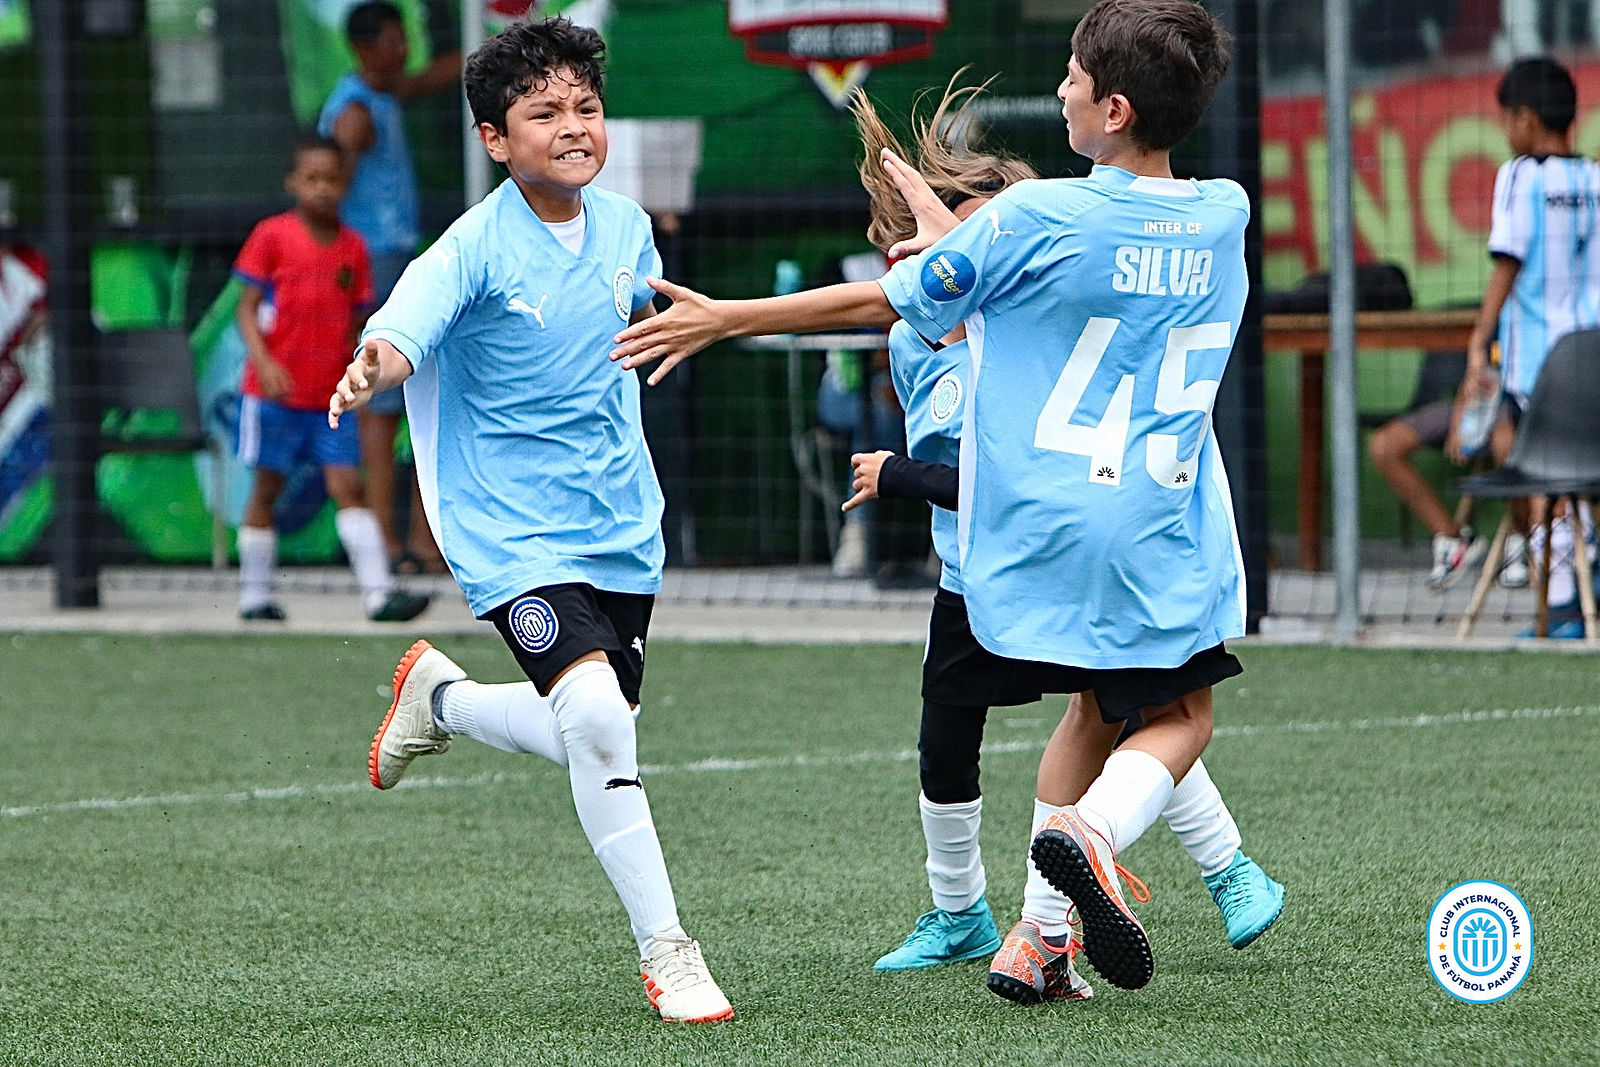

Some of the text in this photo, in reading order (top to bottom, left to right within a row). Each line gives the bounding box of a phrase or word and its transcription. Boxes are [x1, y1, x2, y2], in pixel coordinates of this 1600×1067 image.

[1144, 221, 1203, 235] INTER CF
[1111, 245, 1214, 296] SILVA
[1033, 316, 1231, 490] 45
